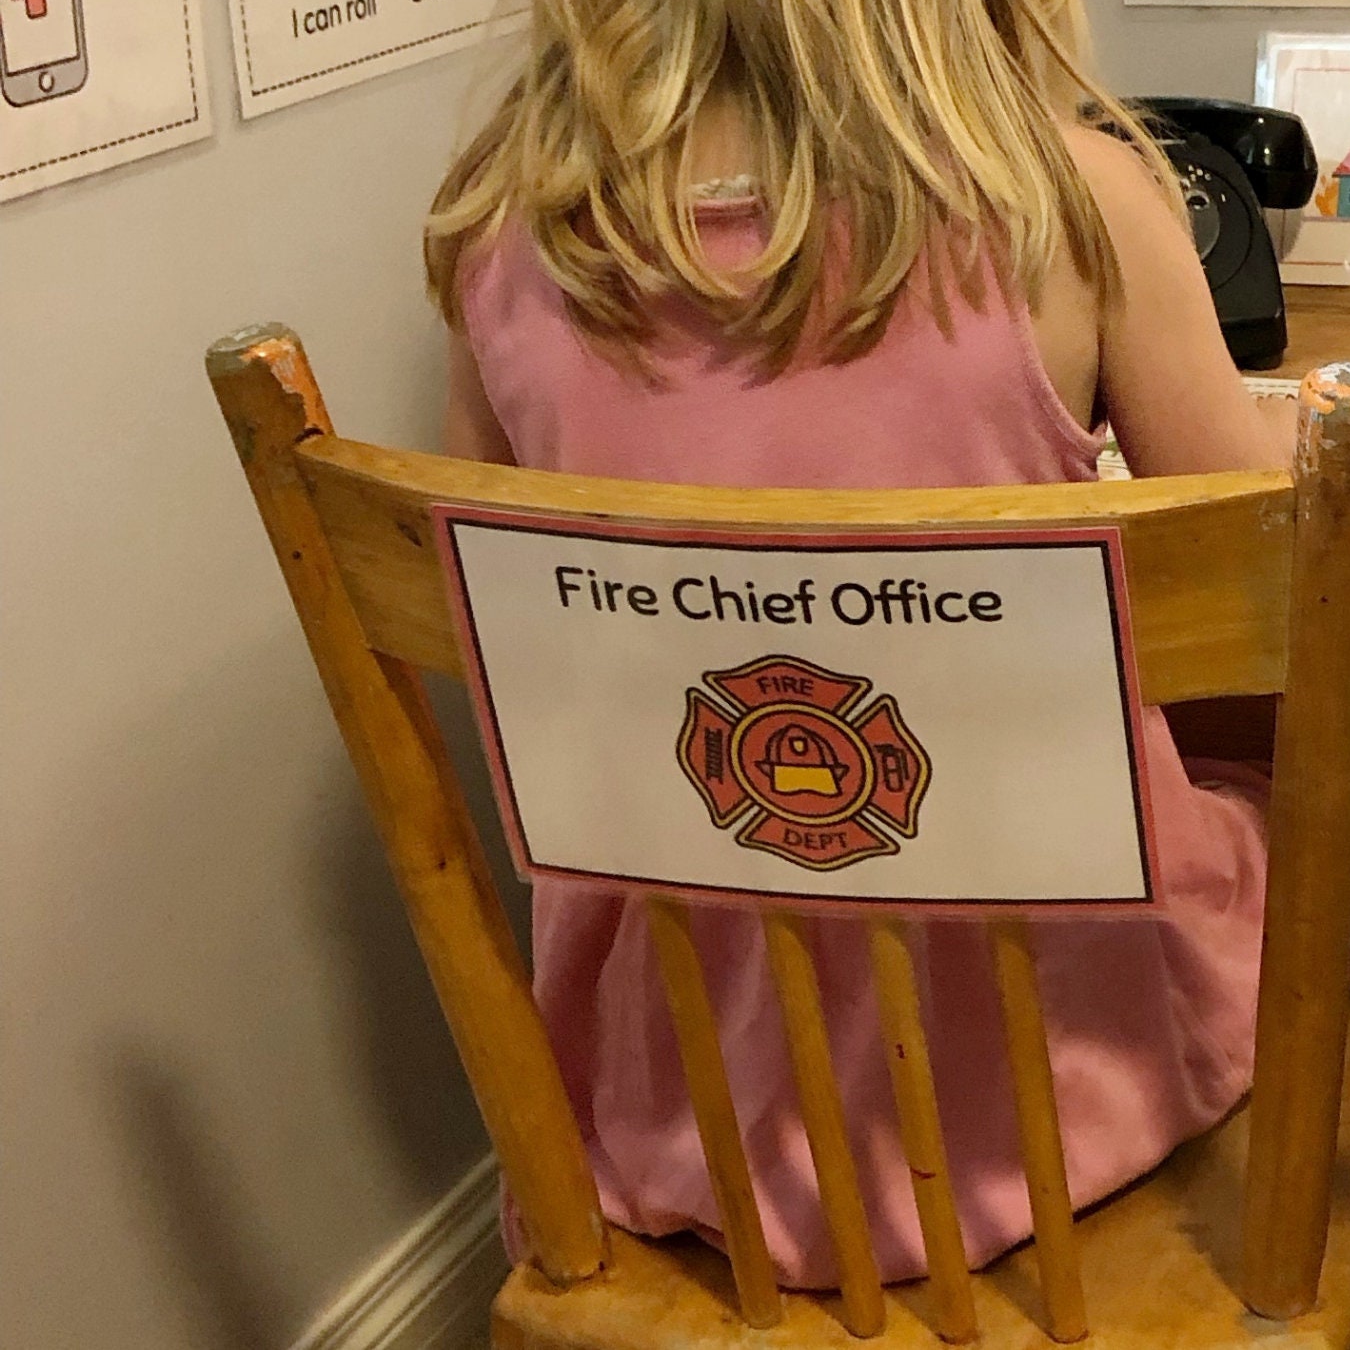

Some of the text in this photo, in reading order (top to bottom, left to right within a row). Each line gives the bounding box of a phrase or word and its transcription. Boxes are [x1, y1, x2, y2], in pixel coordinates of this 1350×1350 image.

[291, 8, 298, 38] I
[303, 4, 342, 35] can
[555, 565, 1004, 626] Fire Chief Office
[756, 675, 815, 697] FIRE
[782, 827, 848, 850] DEPT
